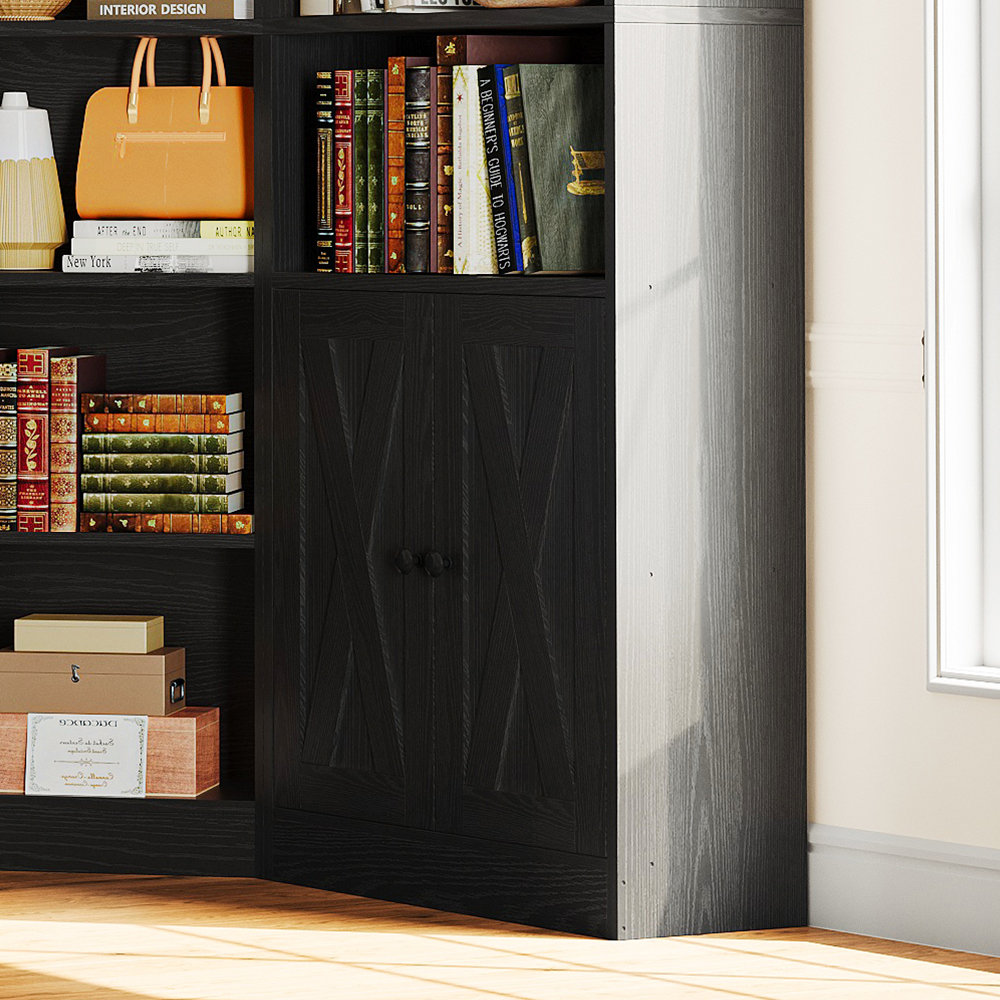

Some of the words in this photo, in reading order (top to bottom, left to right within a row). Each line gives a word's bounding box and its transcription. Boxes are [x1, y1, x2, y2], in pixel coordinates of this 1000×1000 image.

[99, 3, 157, 17] INTERIOR
[161, 3, 207, 16] DESIGN
[478, 78, 491, 87] A
[480, 89, 499, 154] BEGINNER'S
[487, 157, 503, 189] GUIDE
[491, 192, 505, 208] TO
[493, 211, 511, 270] HOGWARTS
[67, 255, 87, 268] New
[89, 255, 112, 268] York
